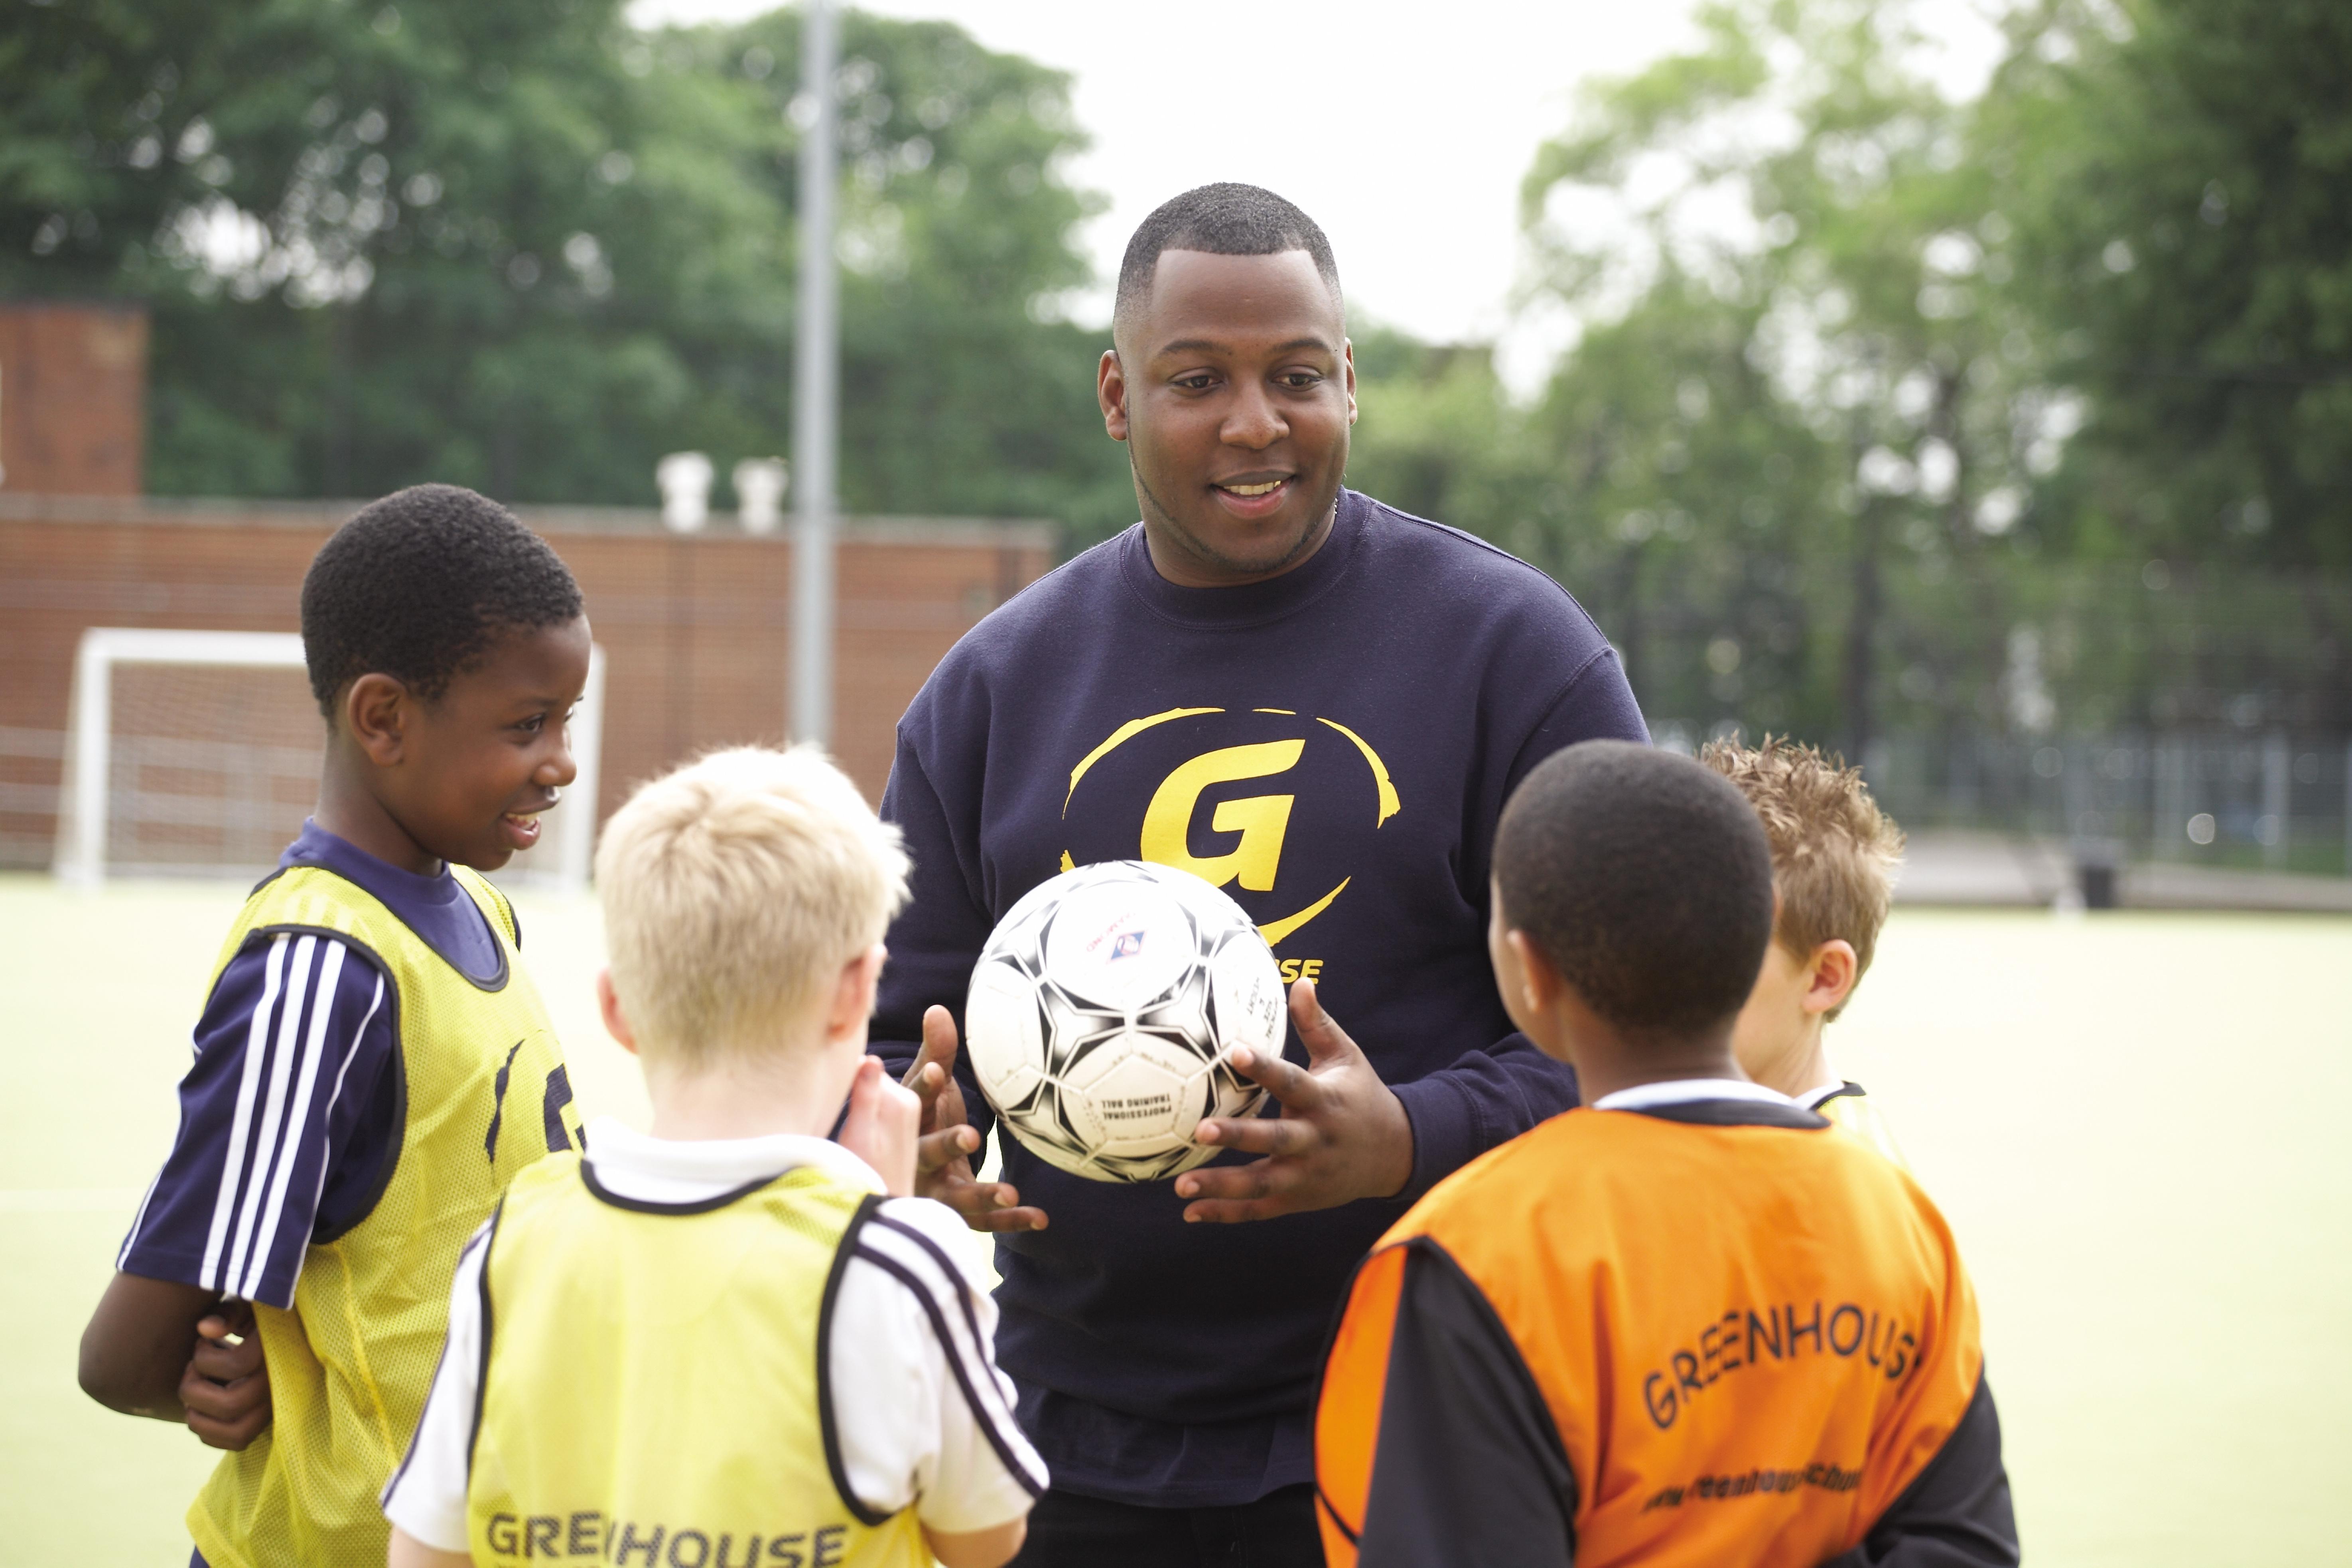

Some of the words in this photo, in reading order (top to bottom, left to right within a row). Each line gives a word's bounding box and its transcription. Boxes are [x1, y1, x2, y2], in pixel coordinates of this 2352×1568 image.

[1141, 739, 1305, 891] G
[1275, 959, 1324, 984] SE
[1102, 1099, 1123, 1108] BALL
[1127, 1093, 1170, 1107] TRAINING
[1104, 1105, 1171, 1120] PROFESSIONAL
[487, 1511, 848, 1568] GREHOUSE
